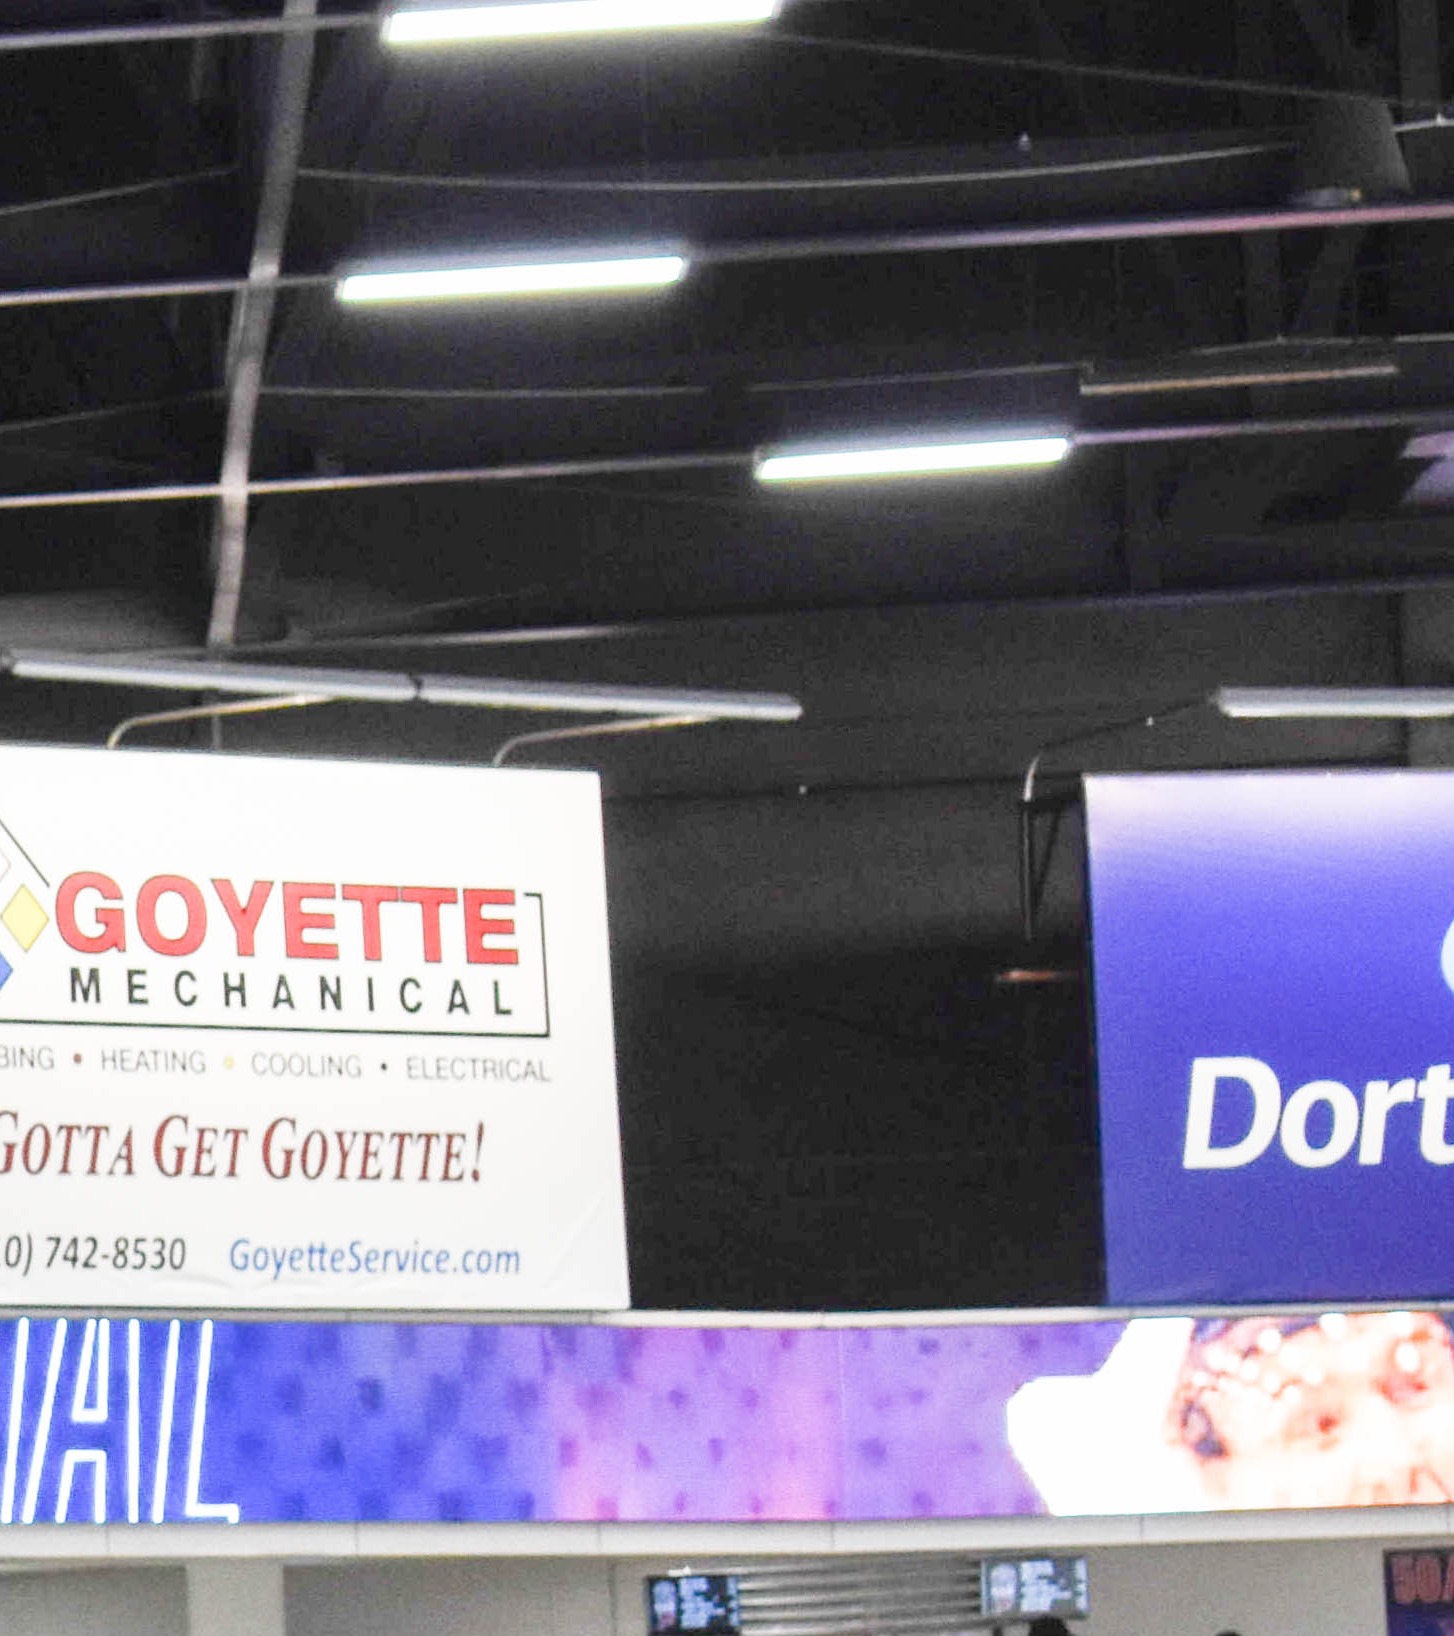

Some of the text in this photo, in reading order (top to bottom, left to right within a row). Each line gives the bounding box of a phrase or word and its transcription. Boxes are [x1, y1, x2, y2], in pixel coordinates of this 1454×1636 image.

[54, 870, 519, 966] GOYETTE
[69, 965, 513, 1017] MECHANICAL
[100, 1048, 207, 1076] HEATING
[250, 1051, 363, 1079] COOLING
[405, 1056, 552, 1083] ELECTRICAL
[44, 1234, 188, 1273] 742-8530
[228, 1239, 521, 1280] GoyetteService.com
